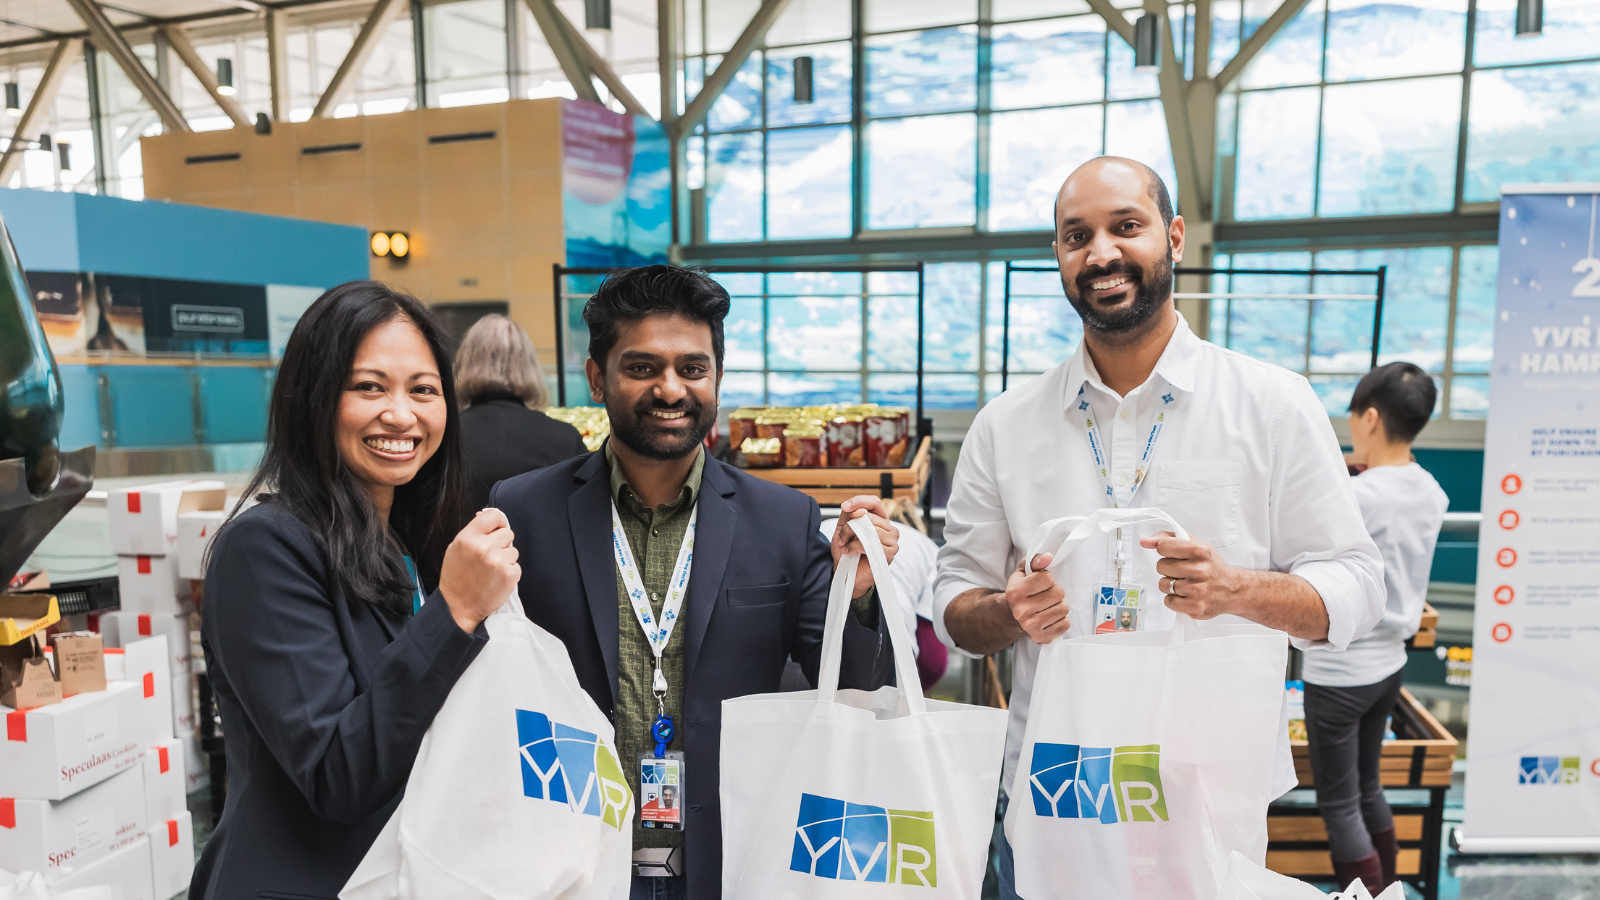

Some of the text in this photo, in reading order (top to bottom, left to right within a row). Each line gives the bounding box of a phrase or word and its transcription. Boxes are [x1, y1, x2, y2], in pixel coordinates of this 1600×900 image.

[1531, 326, 1591, 348] YVR
[1100, 592, 1138, 607] YVR
[61, 753, 111, 782] Speculaas
[642, 771, 678, 784] YVR
[1519, 764, 1579, 783] YVR
[518, 743, 630, 830] YVR
[1029, 769, 1166, 823] YVR
[115, 823, 136, 836] ookies
[794, 820, 934, 888] YVR
